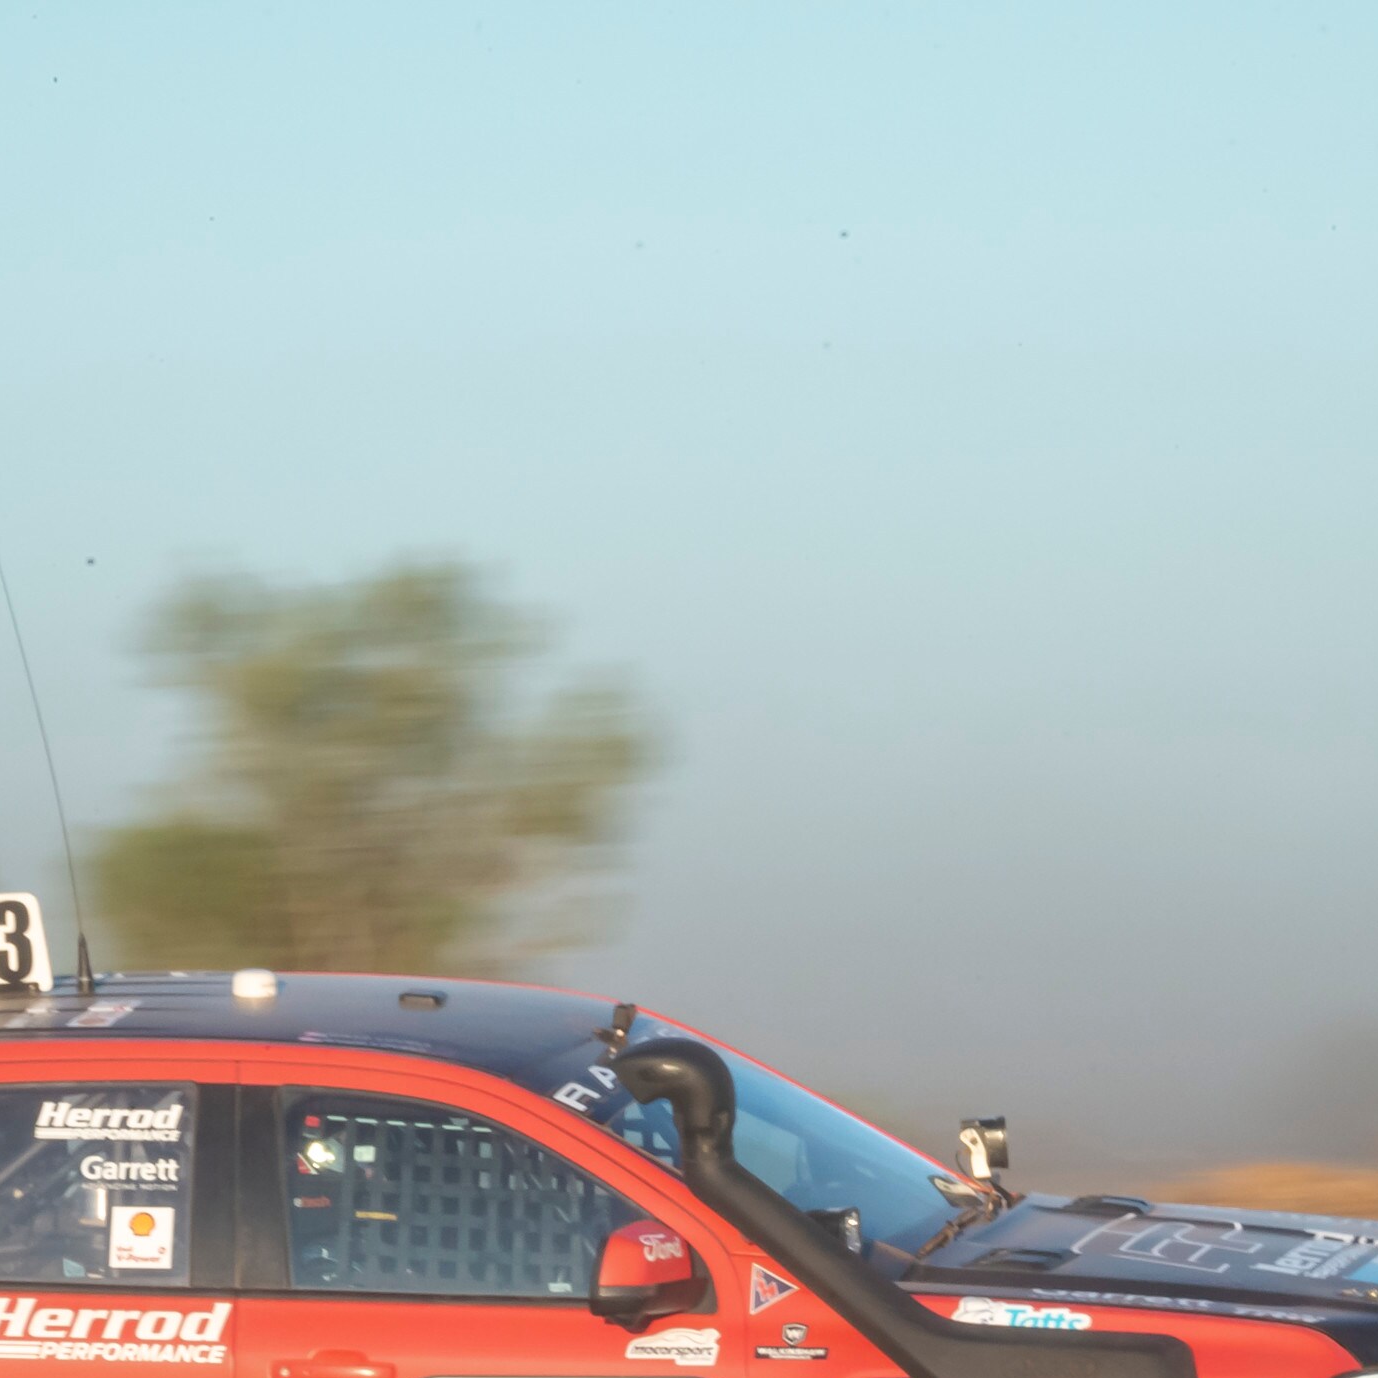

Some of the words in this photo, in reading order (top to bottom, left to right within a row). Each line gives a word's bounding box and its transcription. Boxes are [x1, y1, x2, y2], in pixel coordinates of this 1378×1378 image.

[35, 1101, 183, 1130] Herrod
[80, 1155, 180, 1181] Garrett
[639, 1233, 683, 1262] Ford
[37, 1341, 226, 1363] PERFORMANCE
